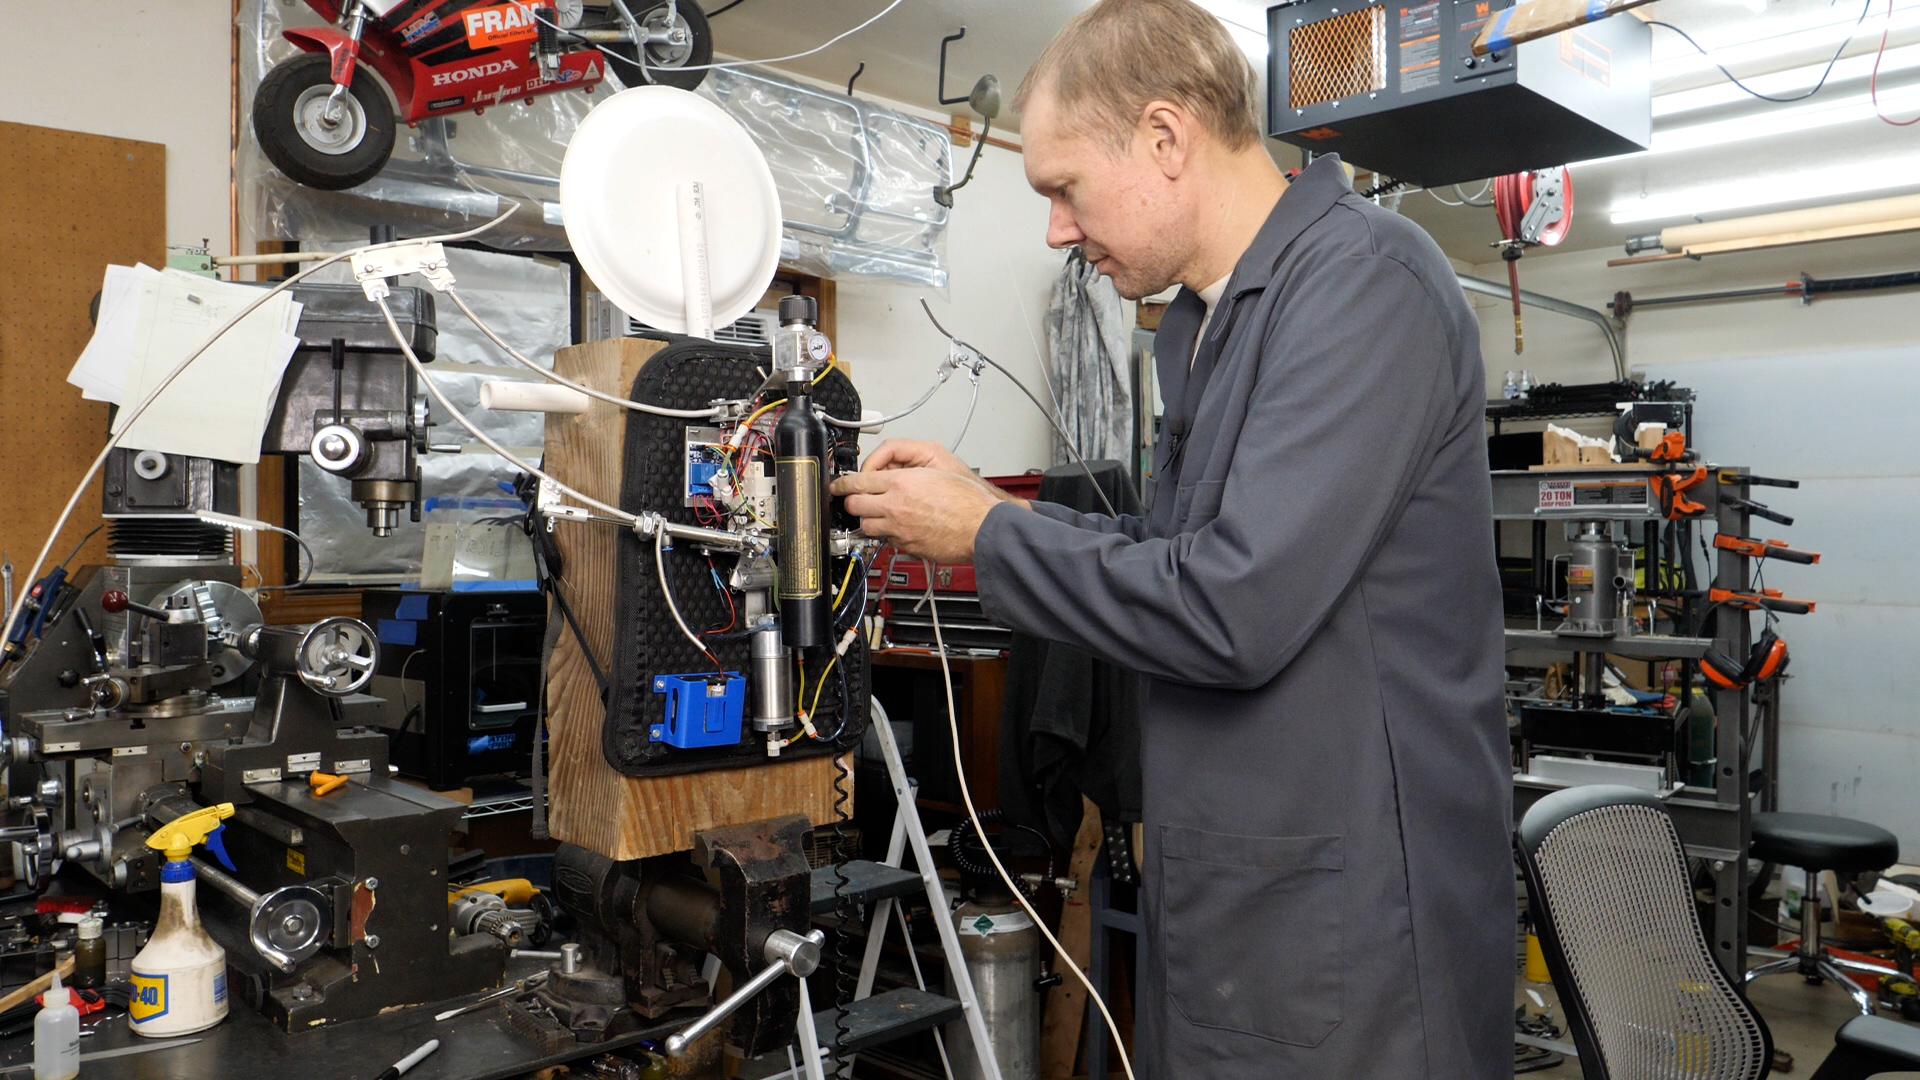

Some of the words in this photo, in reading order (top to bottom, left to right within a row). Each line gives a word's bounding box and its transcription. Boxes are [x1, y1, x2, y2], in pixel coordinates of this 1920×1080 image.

[467, 3, 541, 37] FRAM
[432, 59, 519, 87] HONDA
[1541, 491, 1552, 500] 20
[1555, 491, 1572, 500] TON
[129, 982, 158, 1006] D-40
